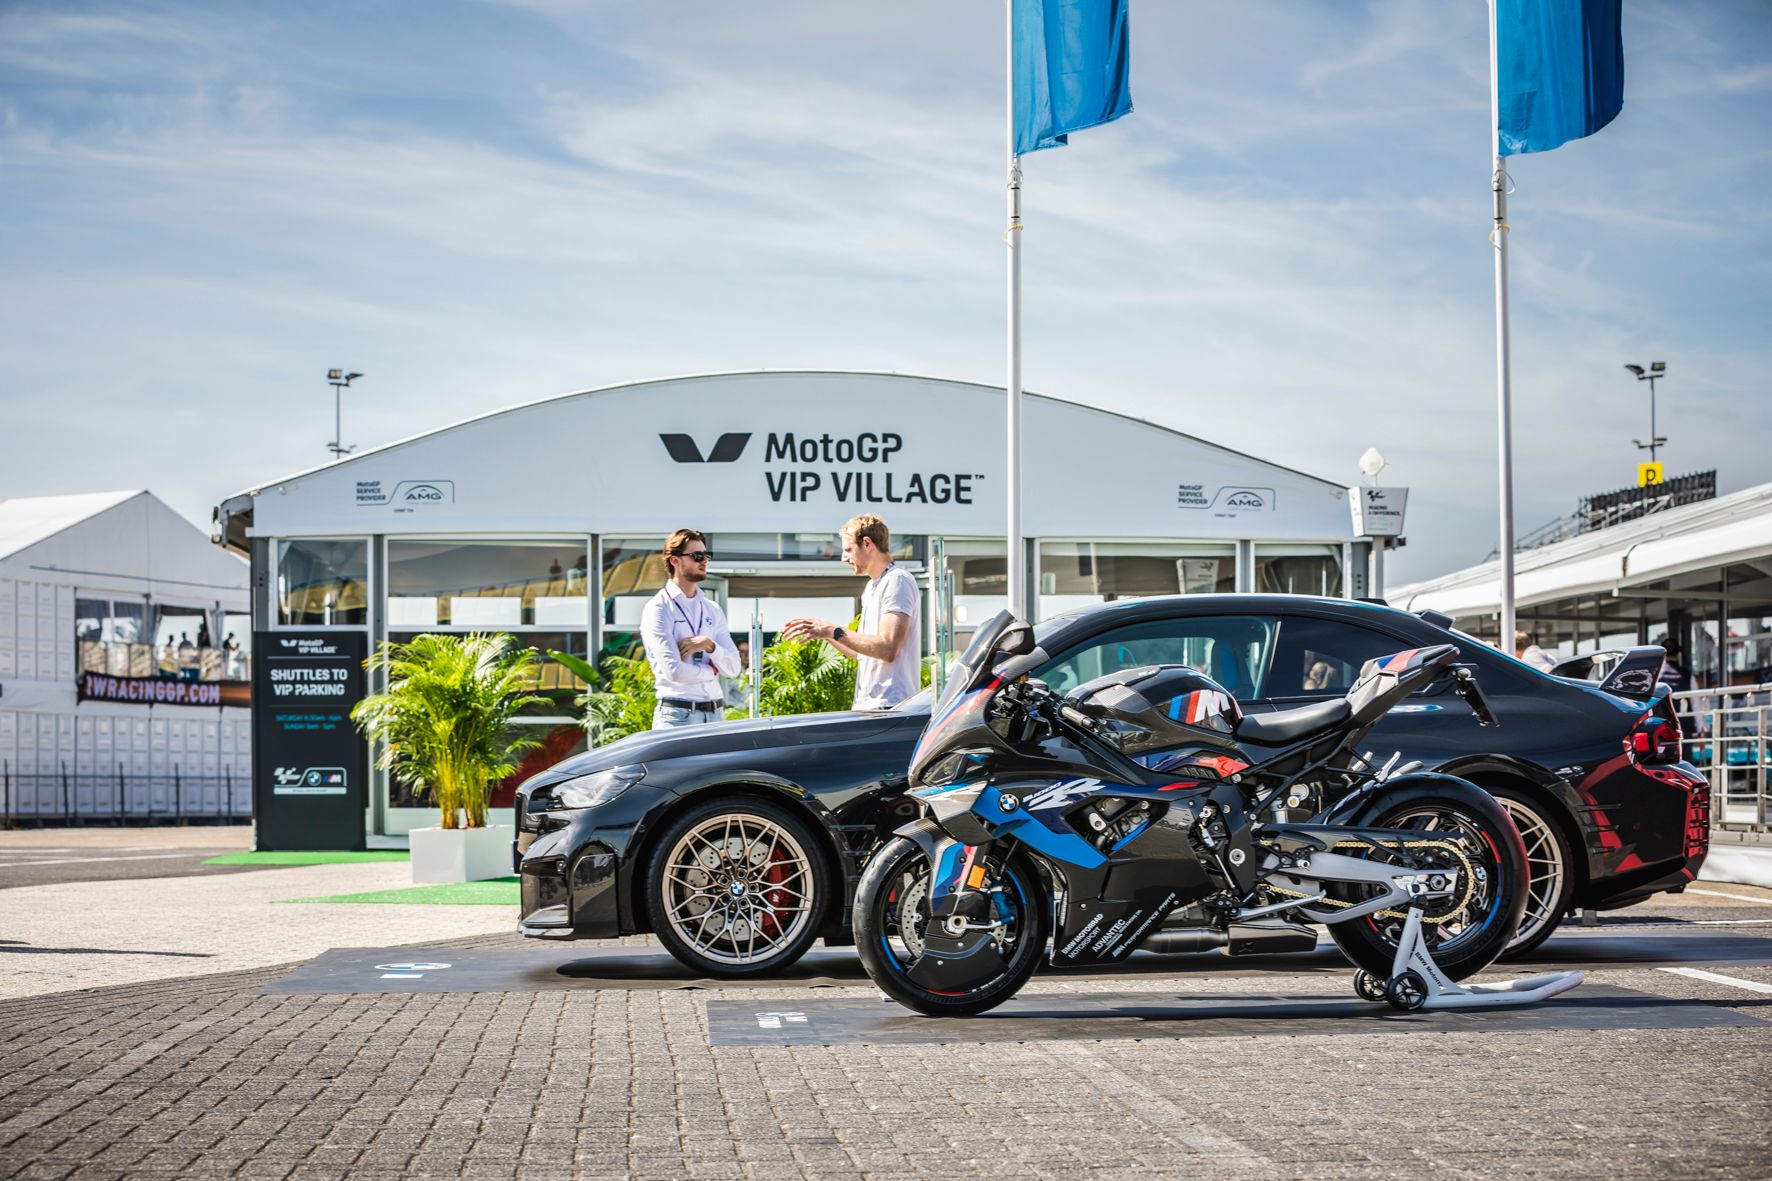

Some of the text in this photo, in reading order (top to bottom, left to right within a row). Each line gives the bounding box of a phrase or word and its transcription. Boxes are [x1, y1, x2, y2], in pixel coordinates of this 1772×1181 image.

[765, 432, 903, 463] MotoGP
[406, 492, 442, 500] AMG
[765, 472, 821, 502] VIP
[1227, 499, 1263, 508] AMG
[270, 668, 348, 681] SHUTTLES TO
[273, 684, 345, 696] VIP PARKING
[1061, 913, 1104, 954] BMW MOTORRAD
[1124, 910, 1160, 947] PERFORMANCE
[1158, 892, 1176, 912] PARTS
[1068, 926, 1102, 958] MOTORSPORT
[1091, 919, 1126, 952] ADVANTEC
